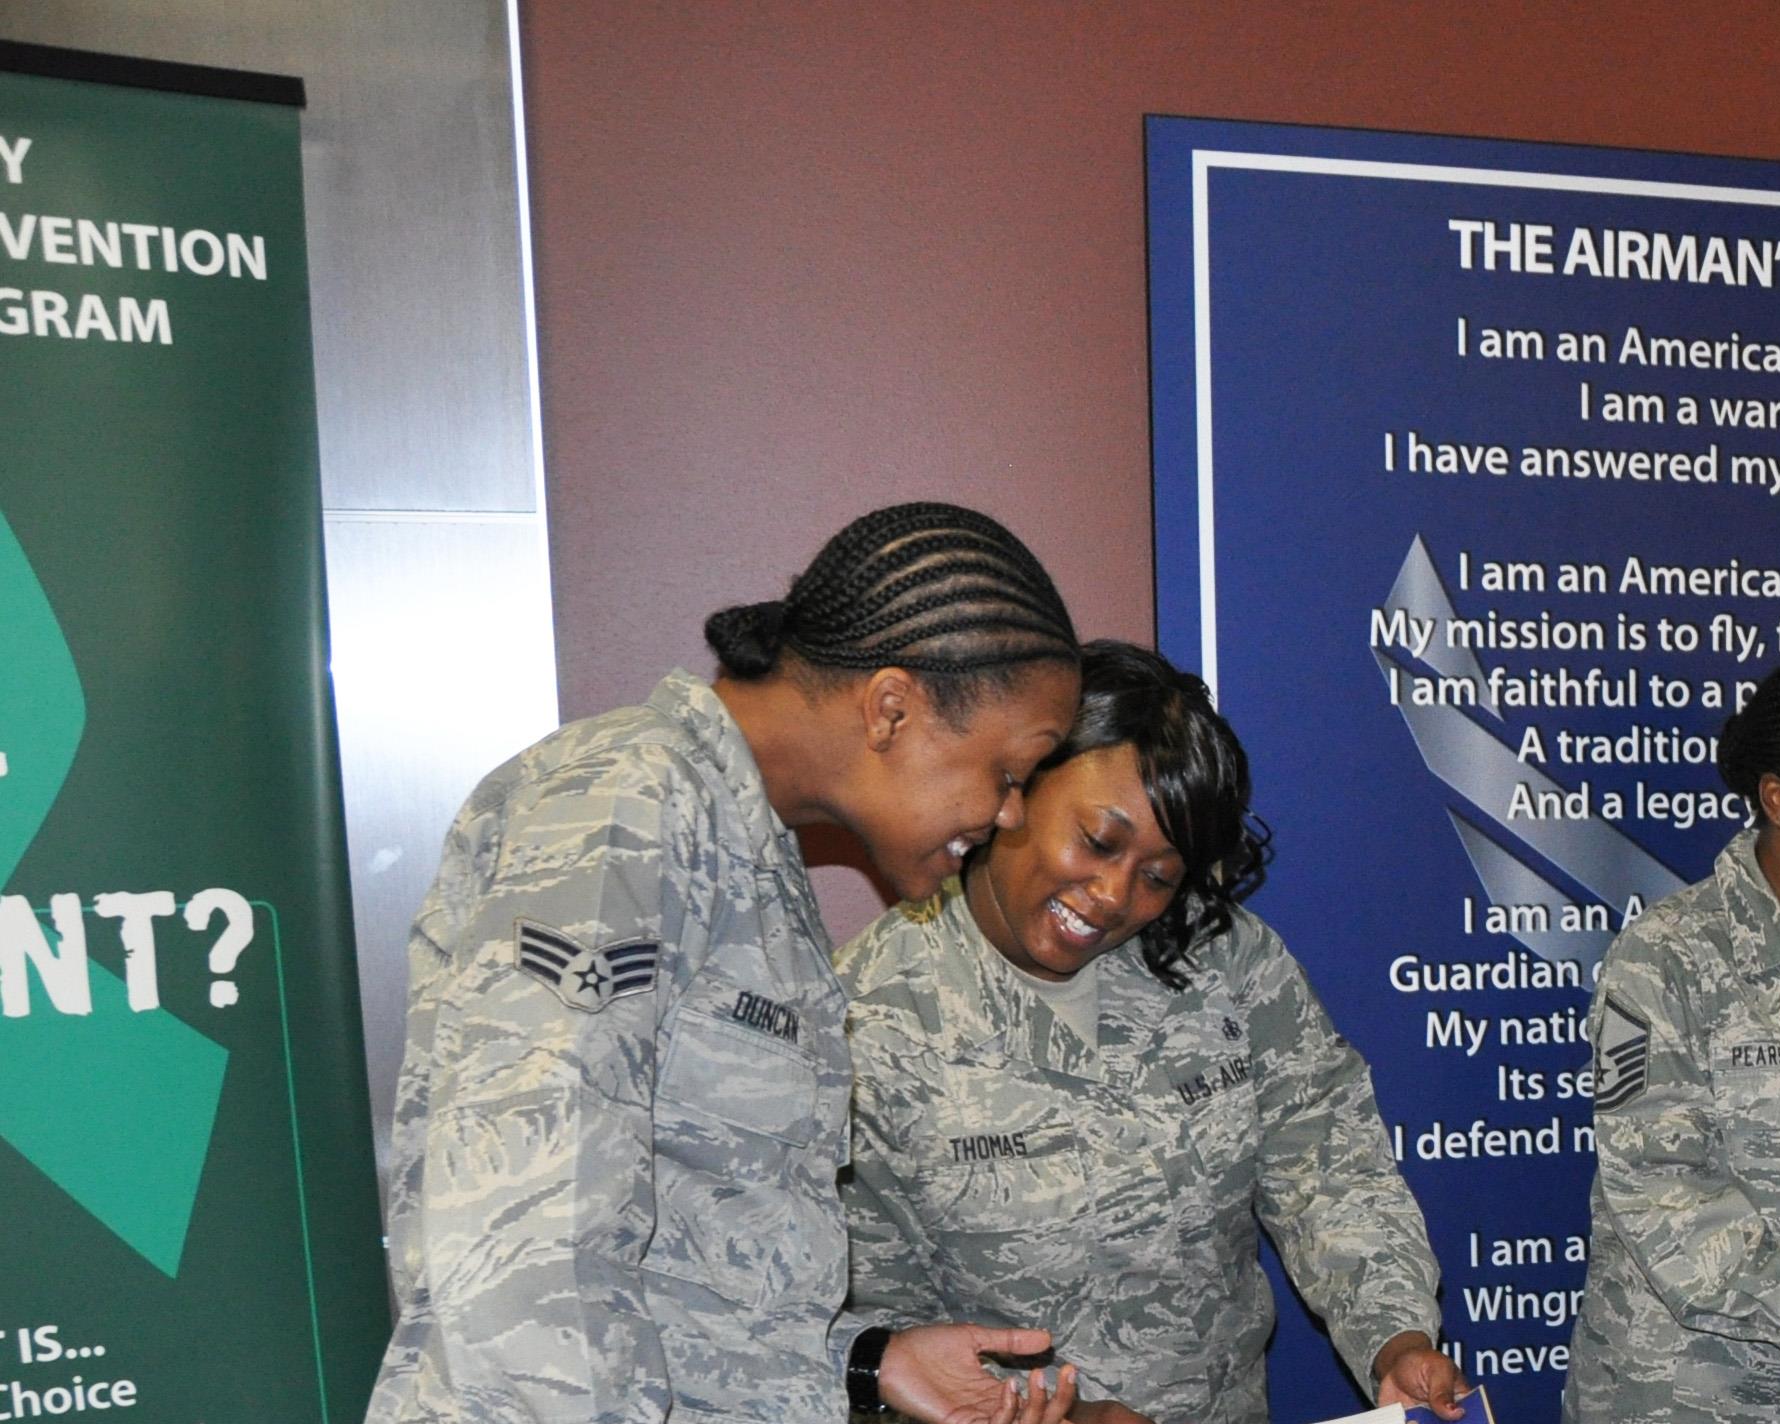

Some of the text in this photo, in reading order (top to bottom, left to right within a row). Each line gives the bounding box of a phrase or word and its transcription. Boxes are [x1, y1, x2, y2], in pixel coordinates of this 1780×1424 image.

[0, 212, 266, 279] VENTION
[1449, 220, 1553, 273] THE
[0, 288, 172, 344] GRAM
[1459, 318, 1465, 356] I
[1480, 330, 1543, 359] am
[1557, 334, 1605, 362] an
[1582, 383, 1588, 419] I
[1603, 394, 1663, 423] am
[1677, 398, 1697, 424] a
[1385, 433, 1393, 471] I
[1409, 432, 1508, 474] have
[1521, 445, 1717, 482] answered
[1460, 553, 1467, 589] I
[1482, 563, 1544, 591] am
[1558, 565, 1606, 592] an
[1370, 610, 1435, 657] My
[1447, 613, 1604, 649] mission
[1617, 618, 1646, 649] is
[1657, 619, 1699, 650] to
[1709, 617, 1765, 662] fly,
[1390, 668, 1399, 705] I
[1411, 676, 1477, 706] am
[1488, 668, 1638, 707] faithful
[1649, 678, 1690, 707] to
[1702, 682, 1722, 708] a
[1518, 728, 1545, 763] A
[1507, 784, 1589, 820] And
[1602, 794, 1623, 819] a
[1464, 899, 1472, 933] I
[1485, 906, 1548, 931] am
[1560, 904, 1608, 930] an
[1389, 955, 1581, 992] Guardian
[732, 991, 800, 1044] DUNCAN
[1426, 1012, 1486, 1054] My
[1498, 1065, 1545, 1101] Its
[949, 1132, 1027, 1162] THOMAS
[1395, 1127, 1403, 1161] I
[1416, 1121, 1560, 1161] defend
[1471, 1234, 1553, 1267] I am
[1477, 1345, 1569, 1376] neve
